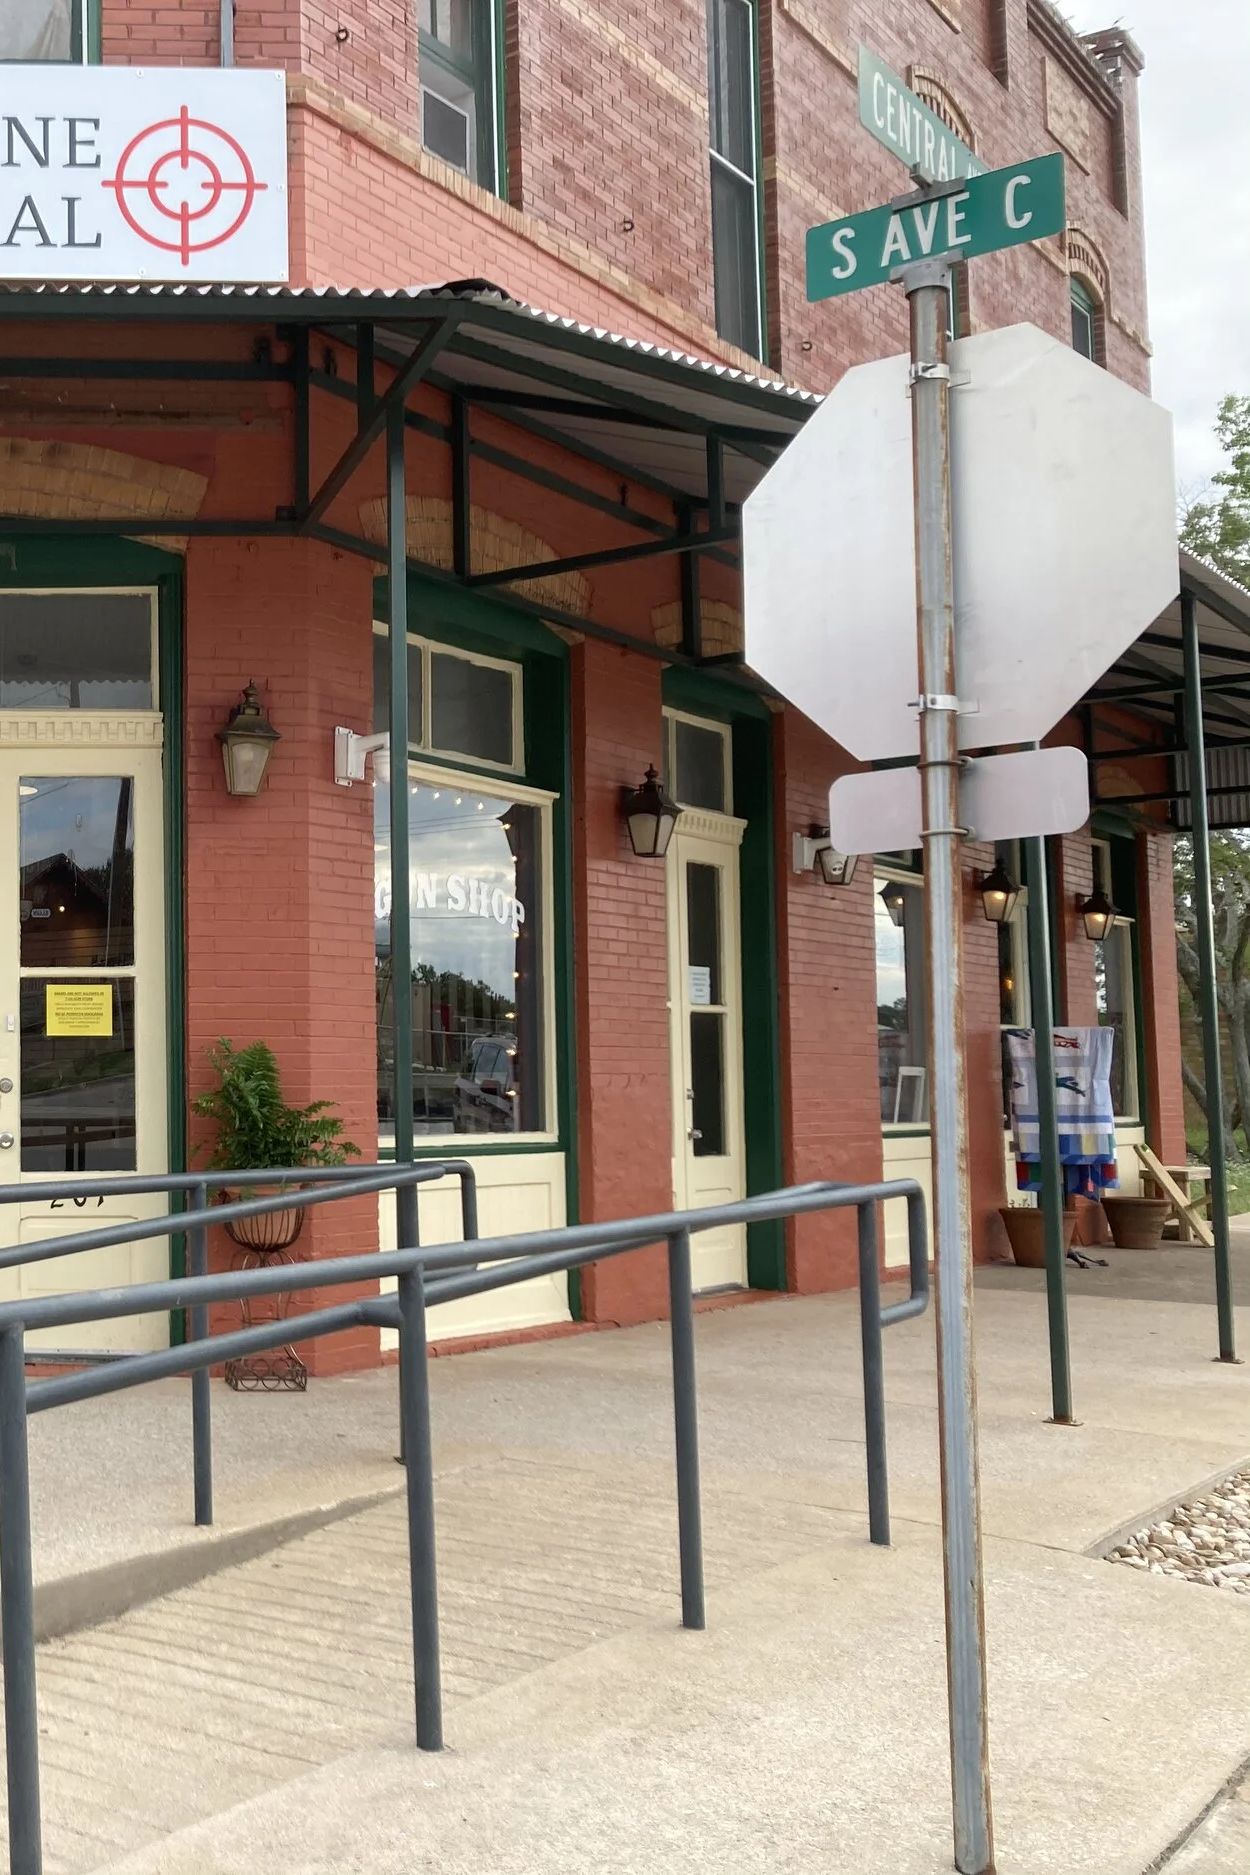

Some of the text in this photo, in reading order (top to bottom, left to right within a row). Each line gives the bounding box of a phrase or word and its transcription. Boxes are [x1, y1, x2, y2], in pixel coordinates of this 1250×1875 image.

[873, 71, 958, 182] CENTRAL
[831, 174, 1034, 280] S AVE C
[374, 872, 526, 934] GN SHOP
